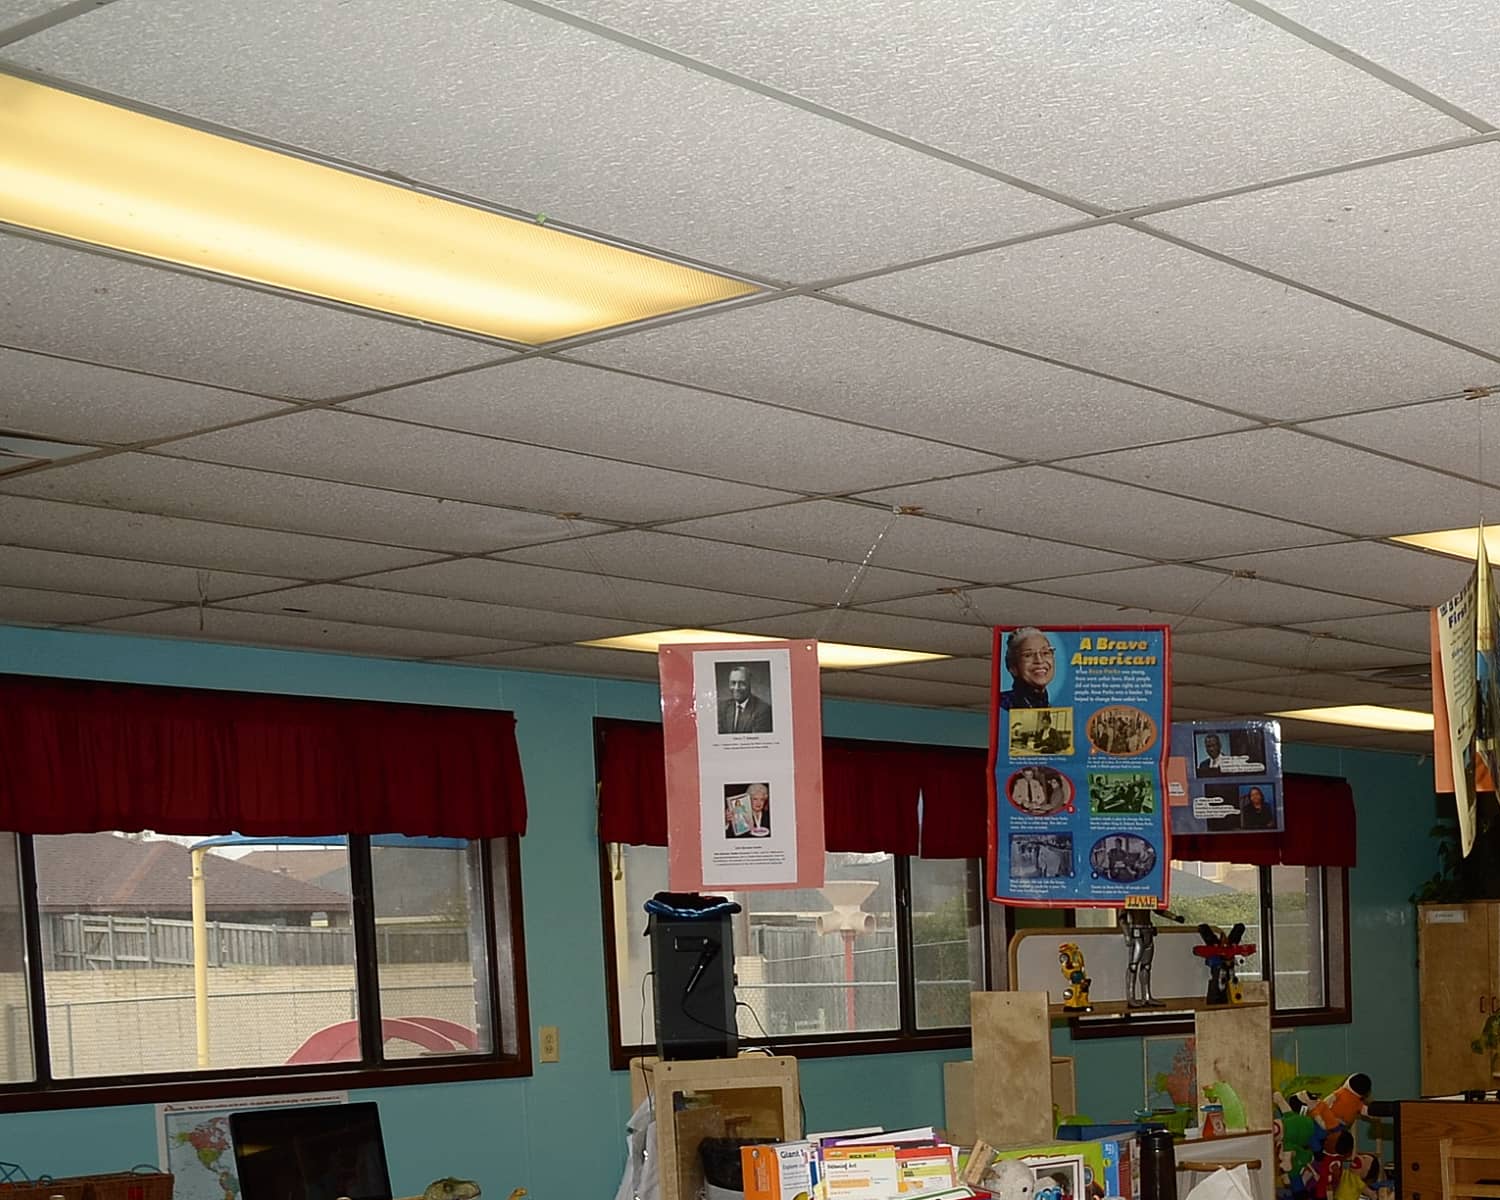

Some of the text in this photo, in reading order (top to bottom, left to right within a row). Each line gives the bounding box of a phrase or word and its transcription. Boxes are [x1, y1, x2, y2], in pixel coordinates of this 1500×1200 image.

[1079, 637, 1148, 650] A Brave
[1071, 652, 1157, 665] American
